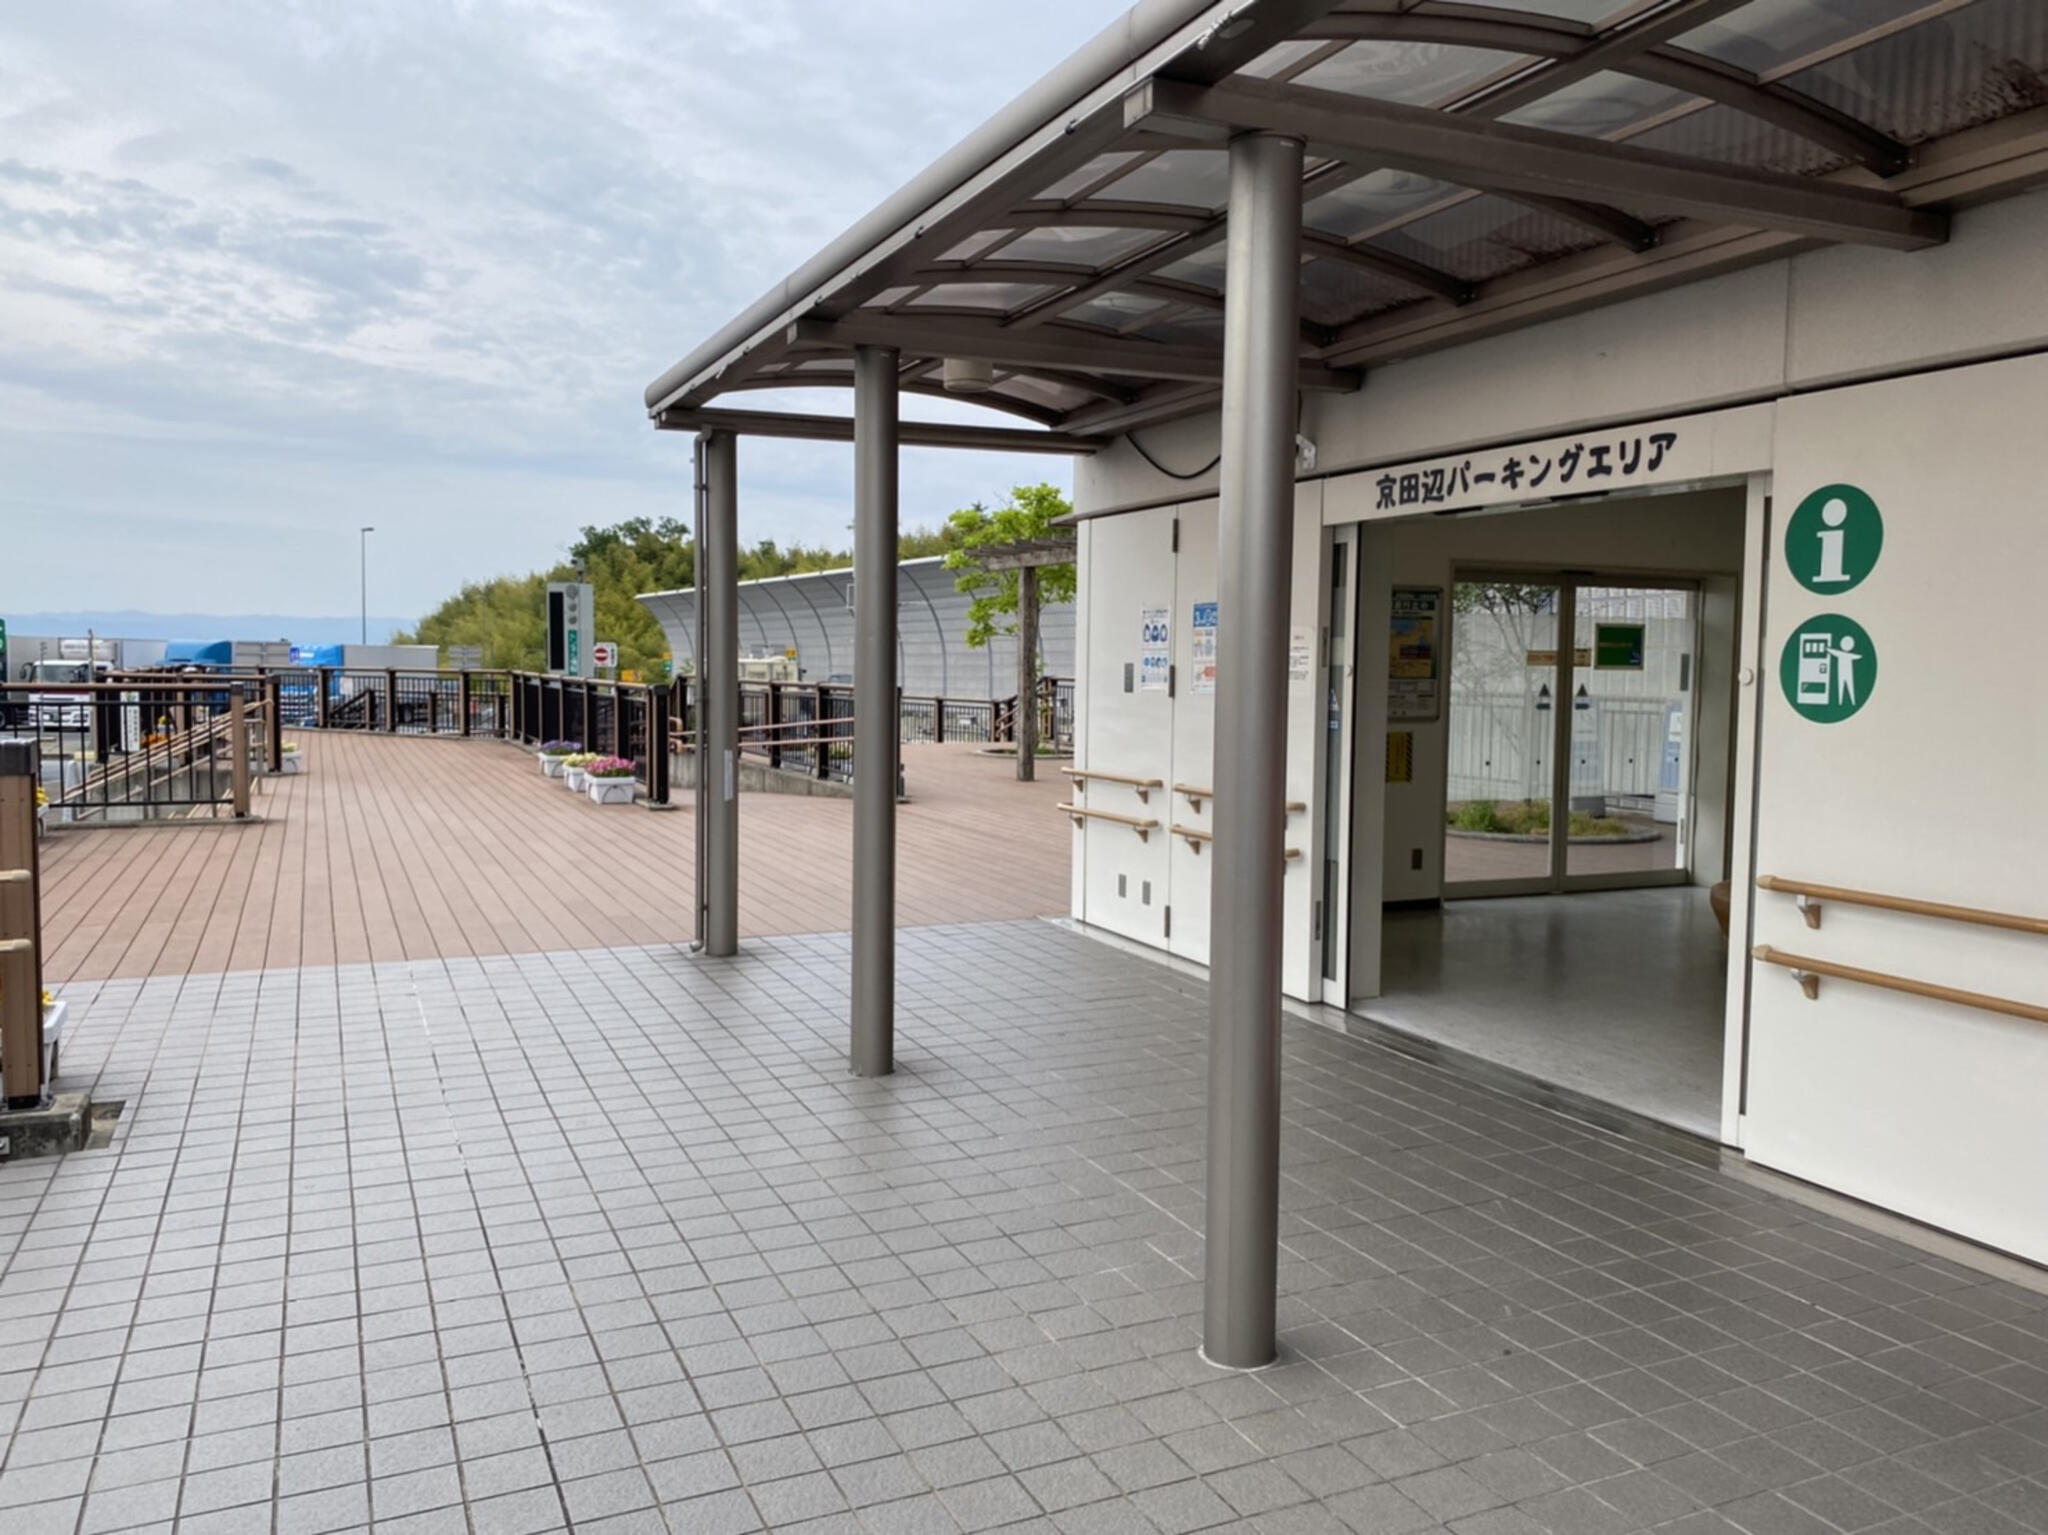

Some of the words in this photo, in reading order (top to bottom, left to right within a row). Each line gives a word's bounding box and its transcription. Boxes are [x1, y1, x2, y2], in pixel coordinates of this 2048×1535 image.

[1376, 432, 1677, 509] 京田辺パーキングエリア
